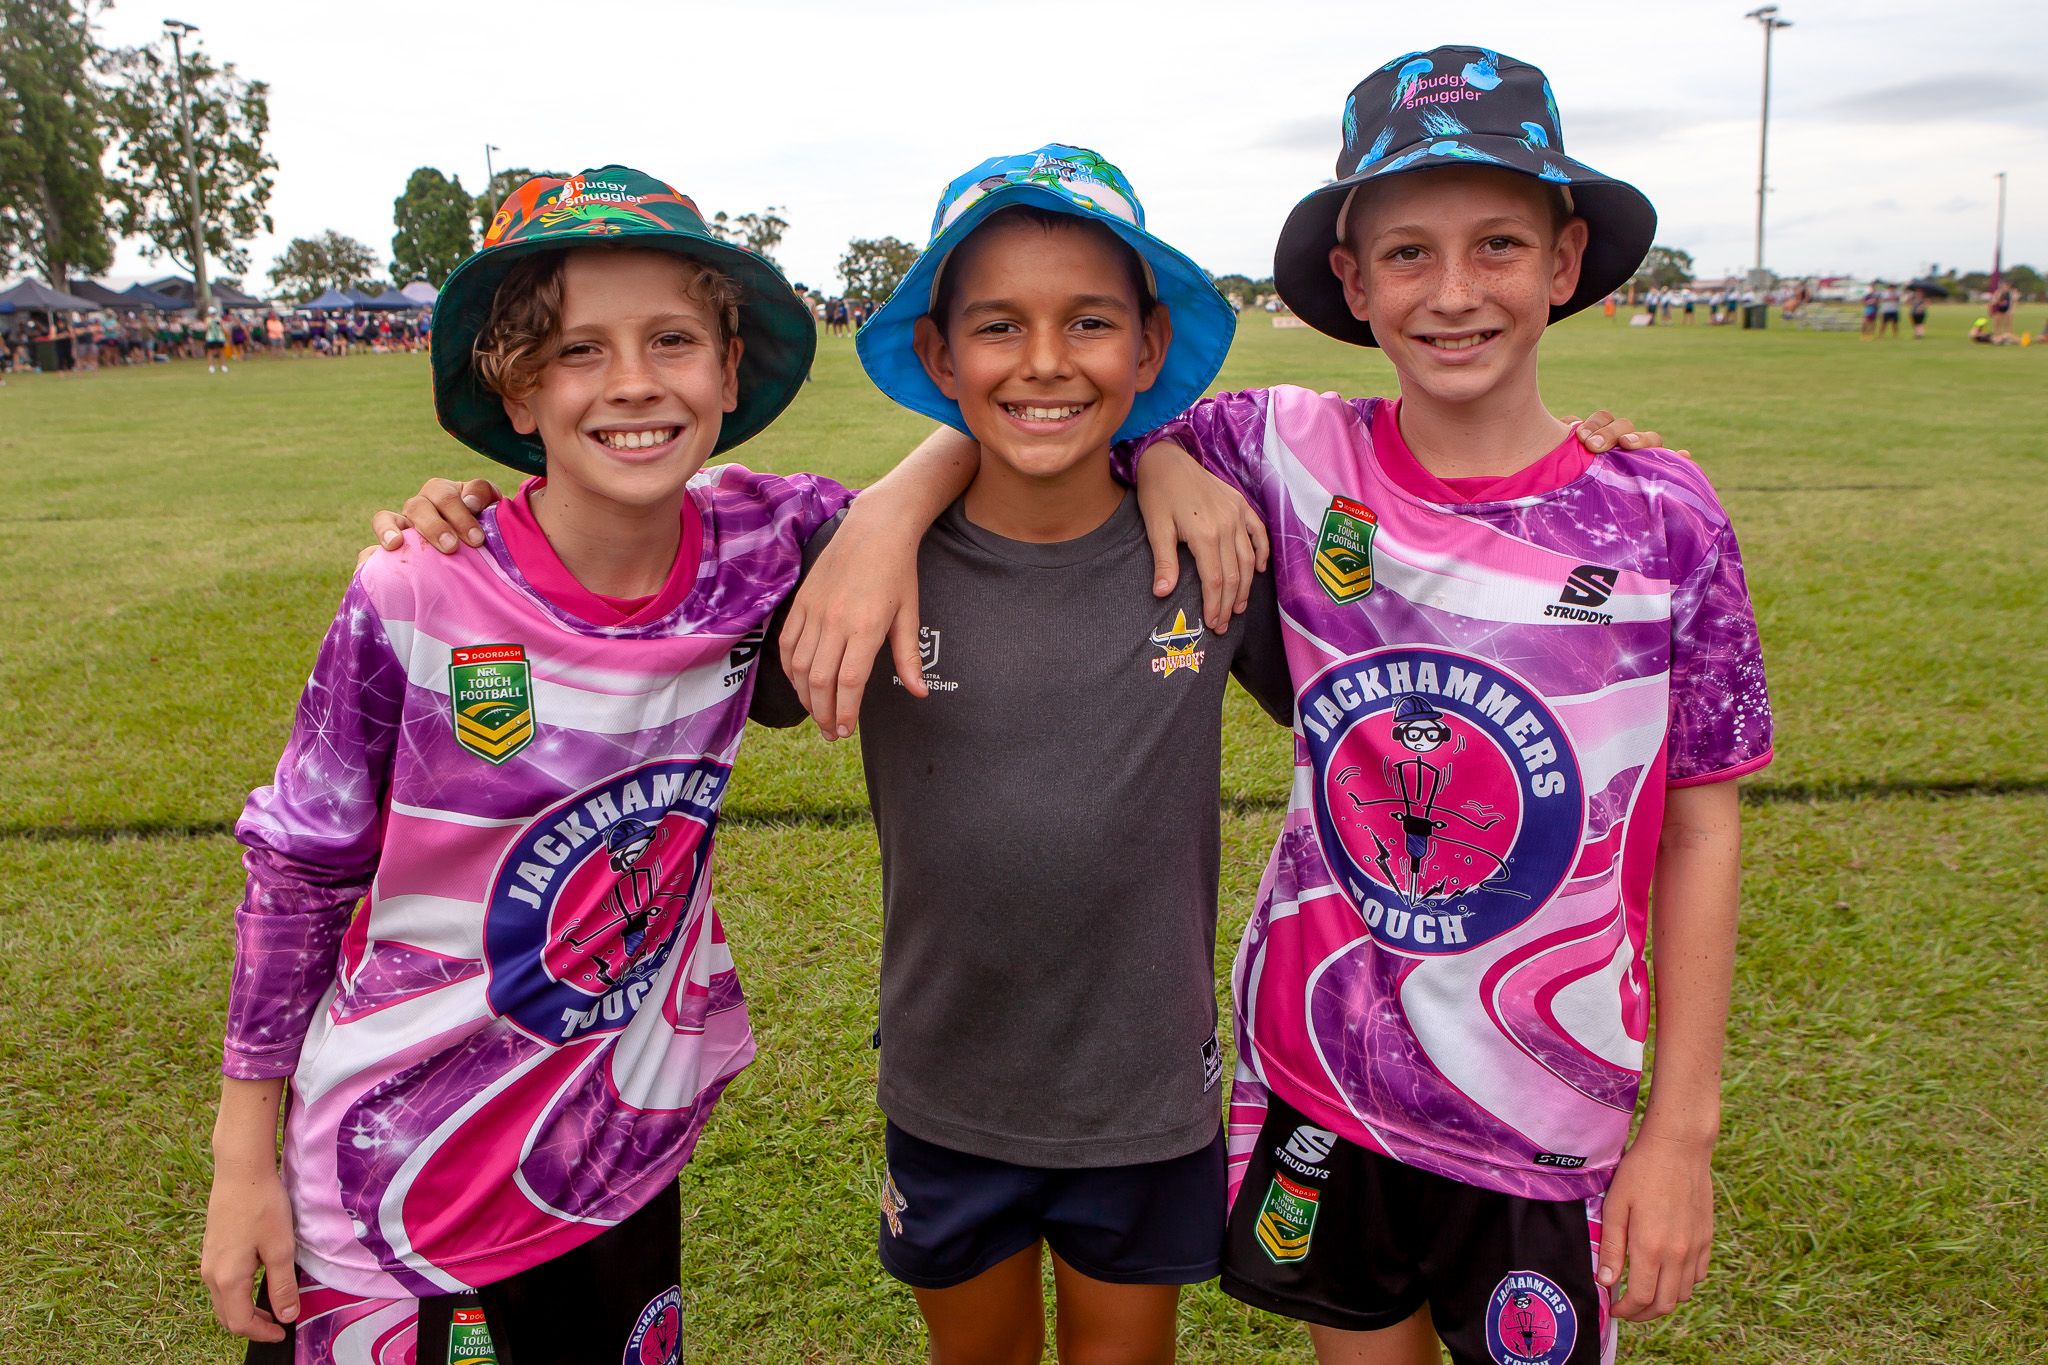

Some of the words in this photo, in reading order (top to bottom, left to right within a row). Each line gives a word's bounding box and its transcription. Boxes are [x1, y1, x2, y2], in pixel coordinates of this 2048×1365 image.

[1418, 74, 1469, 91] budgy
[1406, 88, 1482, 110] smuggler
[1048, 155, 1094, 174] budgy
[574, 180, 628, 192] budgy
[565, 191, 644, 207] smuggler
[1338, 525, 1360, 542] TOUCH
[1327, 532, 1366, 555] FOOTBALL
[1543, 604, 1613, 626] STRUDDYS
[471, 650, 521, 660] DOORDASH
[1151, 650, 1205, 673] COWBOYS
[476, 667, 501, 677] NRL
[468, 676, 512, 689] TOUCH
[460, 687, 523, 701] FOOTBALL
[1302, 661, 1566, 798] JACKHAMMERS
[1274, 1146, 1331, 1180] STRUDDYS
[1538, 1154, 1583, 1167] S-TECH
[1270, 1198, 1309, 1226] FOOTBALL
[1277, 1195, 1304, 1217] TOUCH
